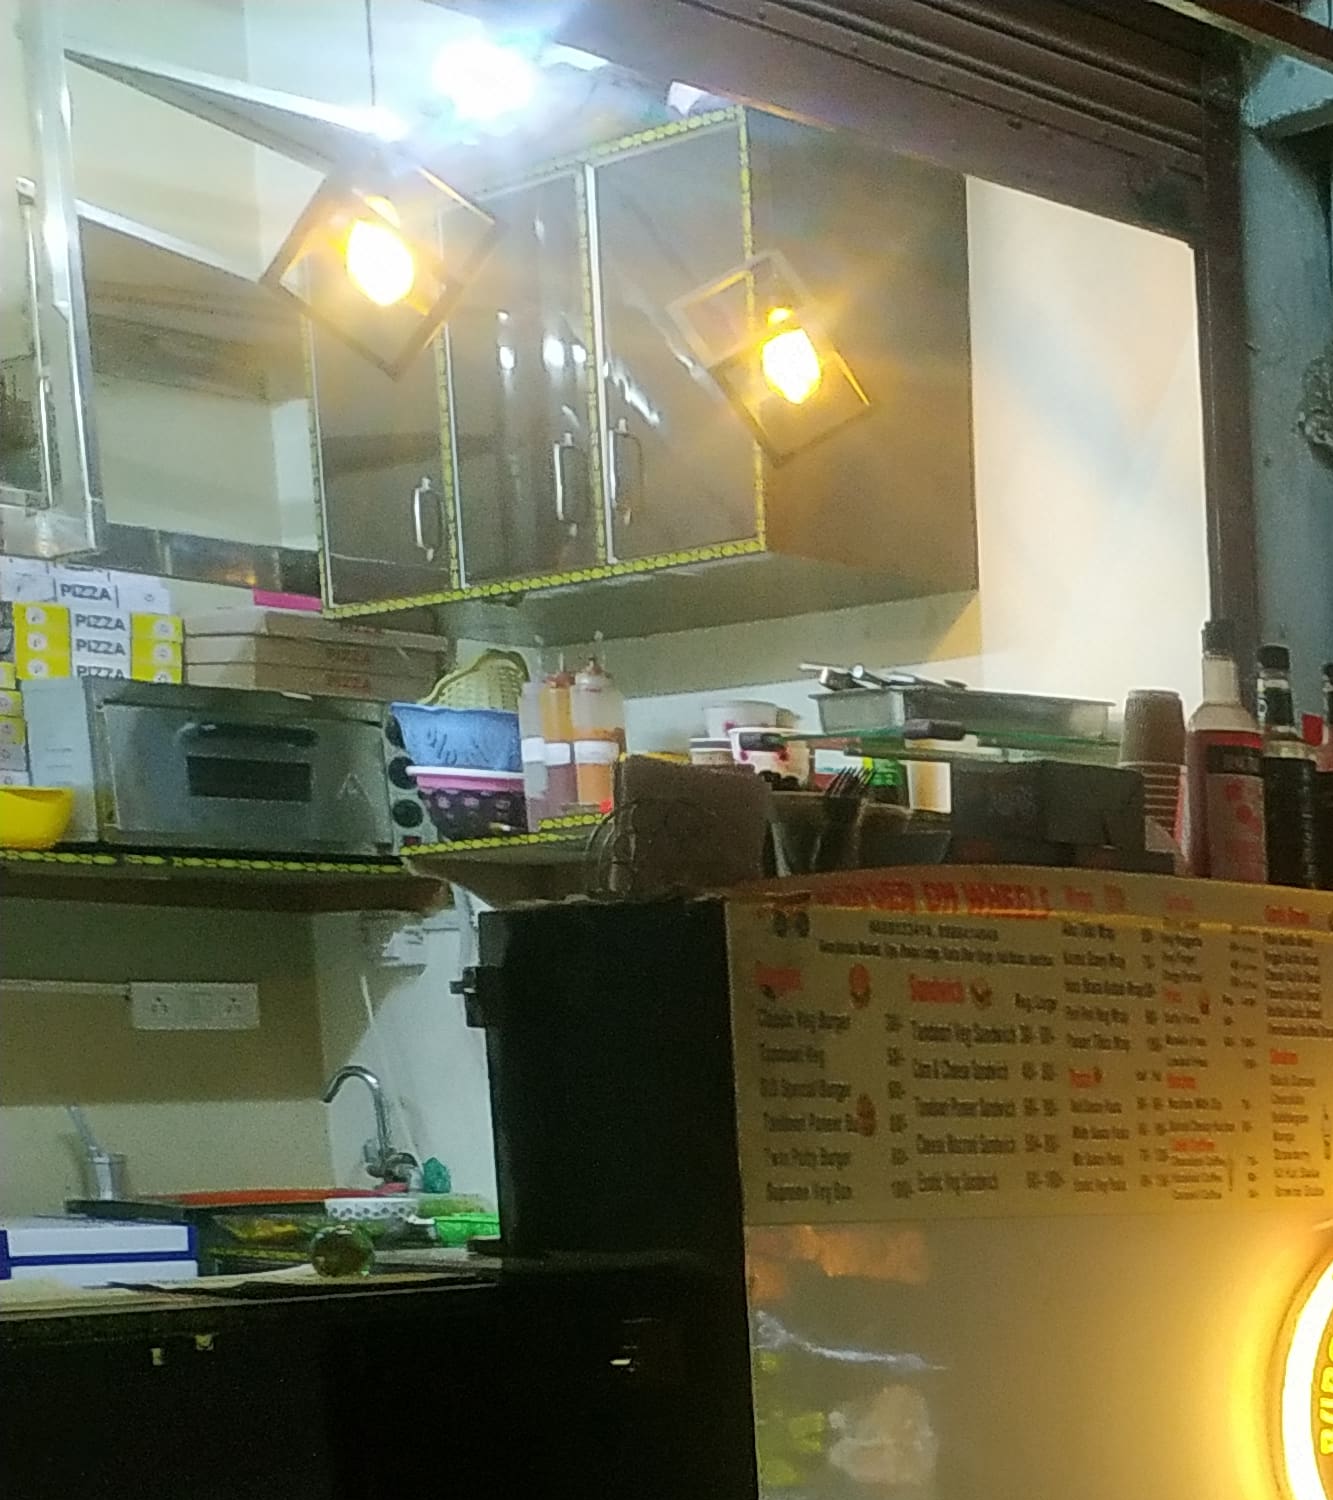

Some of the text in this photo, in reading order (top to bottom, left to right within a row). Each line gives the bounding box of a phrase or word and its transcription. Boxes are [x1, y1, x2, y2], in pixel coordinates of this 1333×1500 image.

[60, 583, 113, 601] PIZZA
[75, 614, 126, 632] PIZZA
[75, 639, 126, 656] PIZZA
